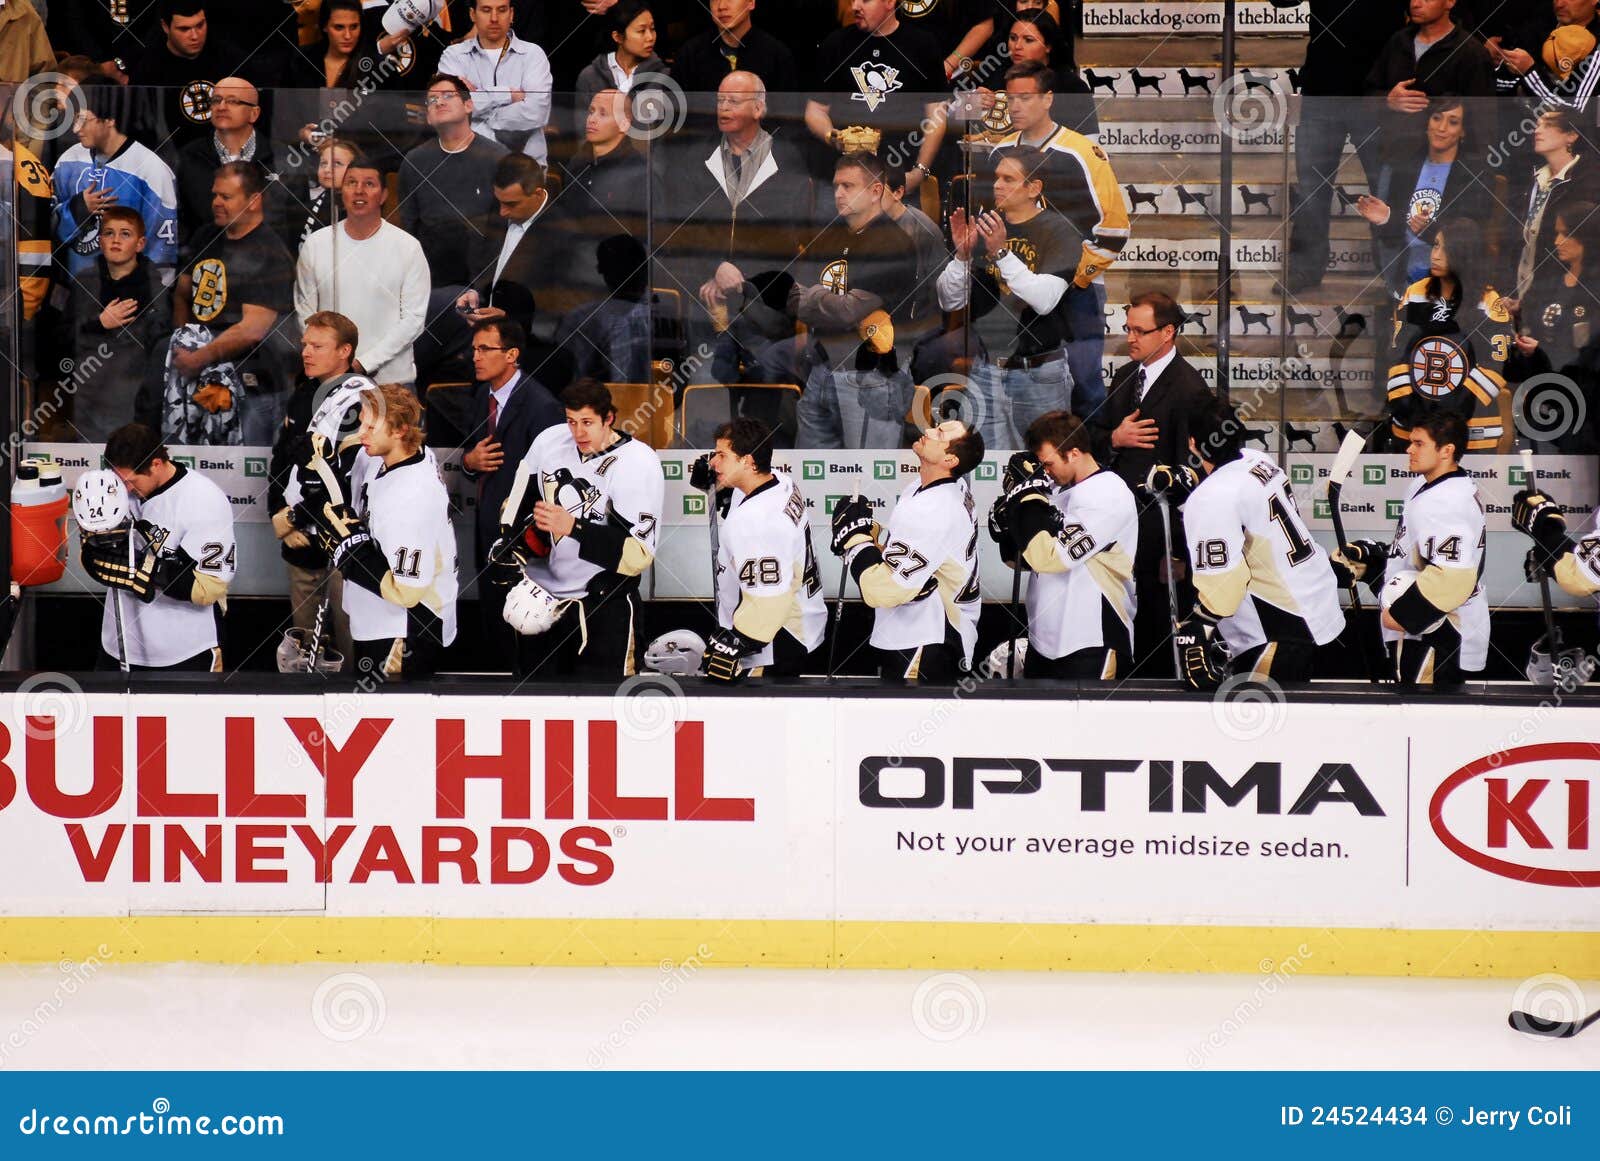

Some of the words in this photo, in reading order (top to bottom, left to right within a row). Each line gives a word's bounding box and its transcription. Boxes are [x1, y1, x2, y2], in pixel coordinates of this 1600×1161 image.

[1084, 8, 1221, 30] theblackdog.com
[1098, 127, 1220, 150] eblackdog.com
[1119, 245, 1218, 267] ackdog.com
[199, 460, 234, 470] Bank
[829, 464, 863, 474] Bank
[1390, 468, 1421, 479] Ban
[1535, 469, 1572, 479] Bank
[228, 495, 257, 505] ank
[1340, 503, 1375, 513] Bank
[1485, 503, 1514, 514] Ban
[635, 512, 658, 541] 7
[834, 517, 873, 548] ASTON
[199, 541, 238, 573] 24
[392, 546, 423, 580] 11
[884, 541, 930, 581] 27
[1196, 538, 1230, 571] 18
[1424, 534, 1465, 564] 14
[739, 556, 782, 589] 48
[0, 715, 395, 819] ULLY
[435, 718, 756, 822] HILL
[858, 755, 1388, 817] OPTIMA
[63, 823, 615, 887] VINEYARDS
[896, 831, 946, 852] Not
[955, 835, 1017, 856] your
[1025, 835, 1135, 858] average
[1144, 834, 1250, 857] midsize
[1259, 837, 1350, 859] sedan.
